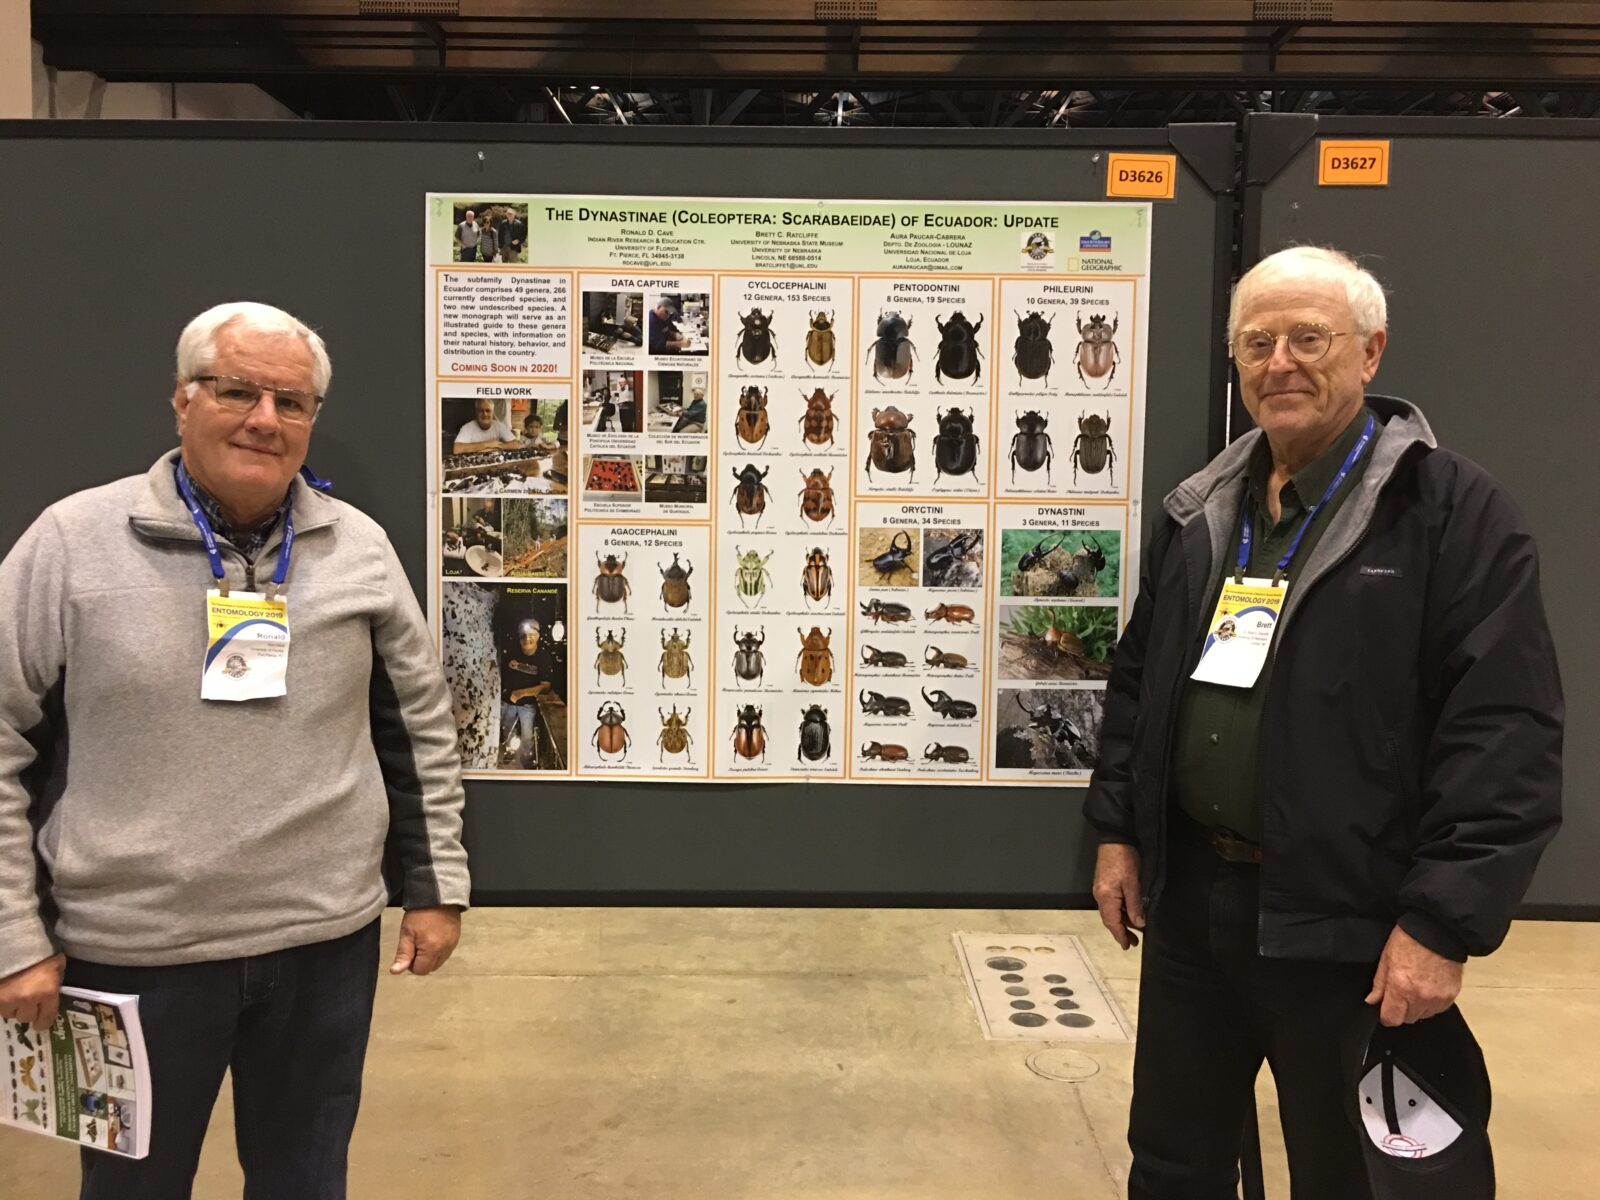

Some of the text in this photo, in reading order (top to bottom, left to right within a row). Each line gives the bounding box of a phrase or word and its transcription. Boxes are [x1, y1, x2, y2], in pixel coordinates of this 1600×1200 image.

[1331, 158, 1376, 170] D3627
[1119, 170, 1162, 183] D3626
[546, 208, 1059, 229] THE DYNASTINAE (COLEOPTERA: SCARABAEIDAE) OF ECUADOR: UPDATE
[444, 274, 458, 282] The
[452, 363, 487, 372] COMING
[491, 363, 516, 372] SOON
[531, 364, 557, 372] 2020!
[1223, 595, 1265, 604] ENTOMOLOGY
[212, 607, 264, 617] ENTOMOLOGY
